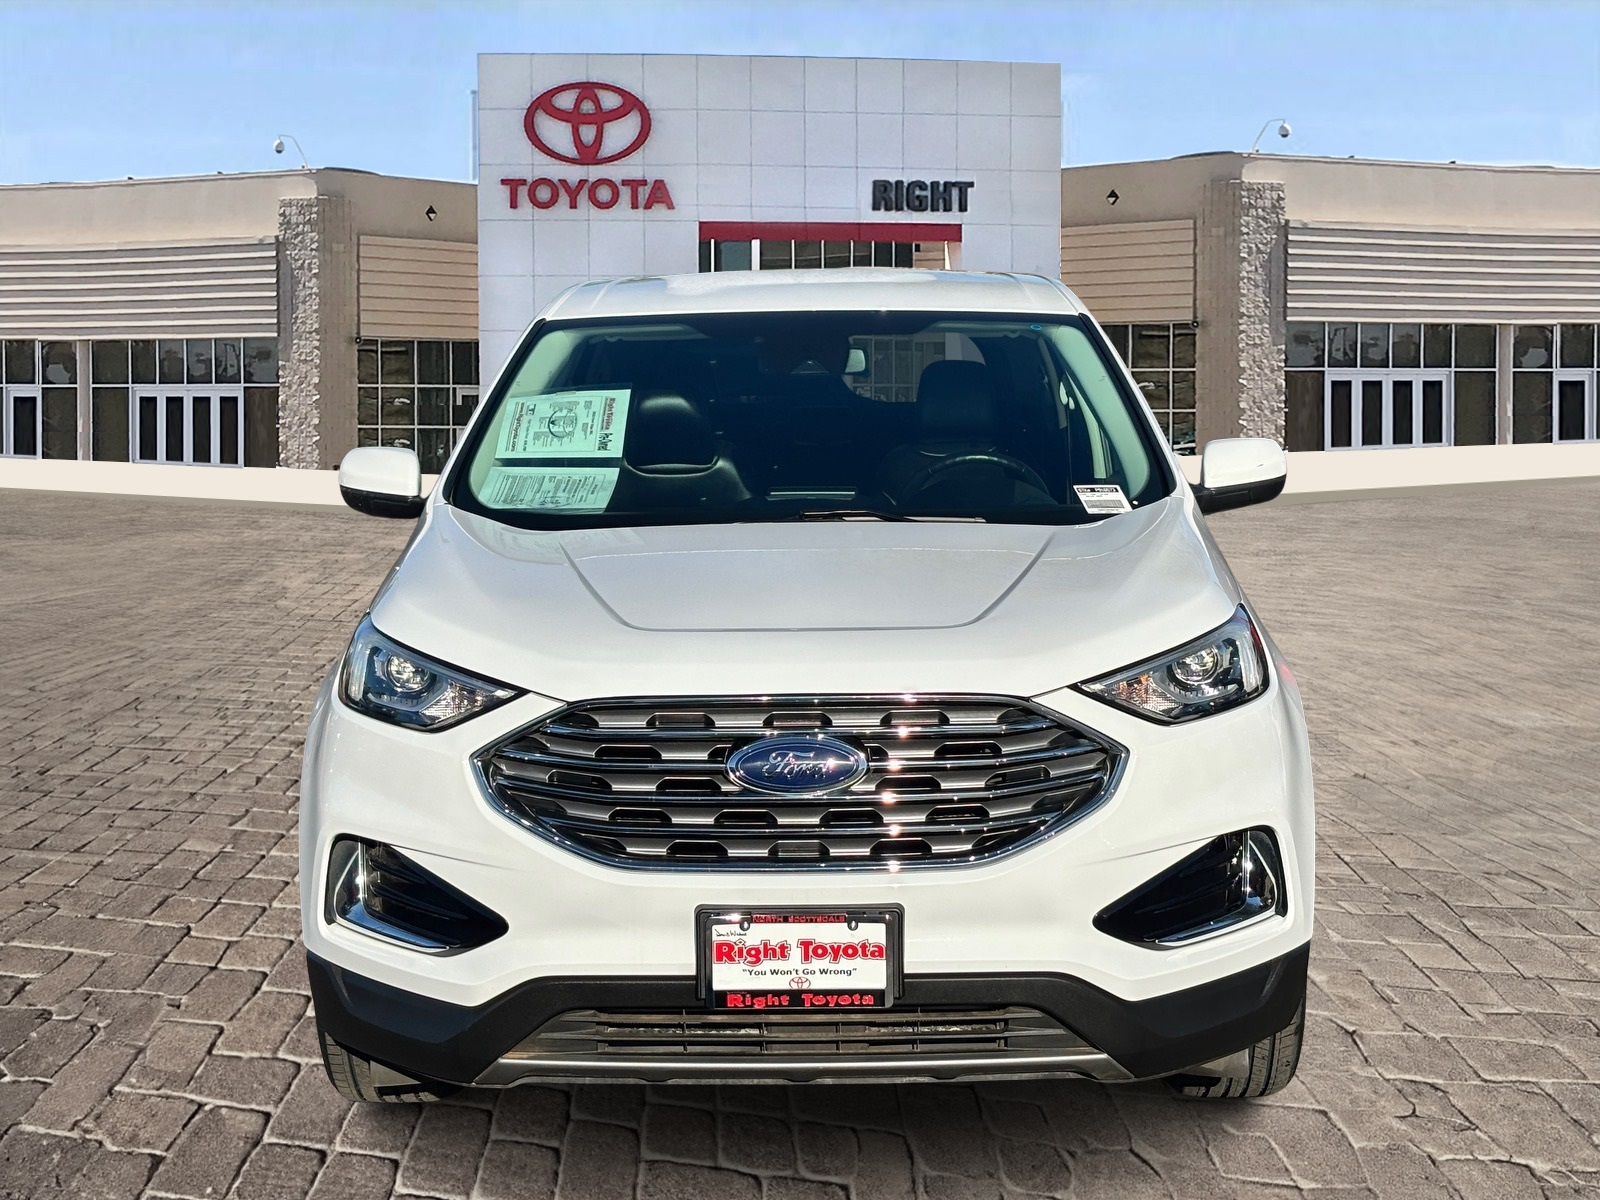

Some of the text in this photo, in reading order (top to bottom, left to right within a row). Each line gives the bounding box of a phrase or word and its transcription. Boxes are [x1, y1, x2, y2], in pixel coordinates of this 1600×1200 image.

[500, 177, 675, 210] TOYOTA
[871, 179, 975, 213] RIGHT
[761, 750, 833, 779] Ford
[752, 914, 846, 923] NORTH SCOTTSDALE
[713, 938, 887, 966] Right Toyota
[802, 968, 816, 976] Go
[726, 993, 875, 1009] Right Toyota
